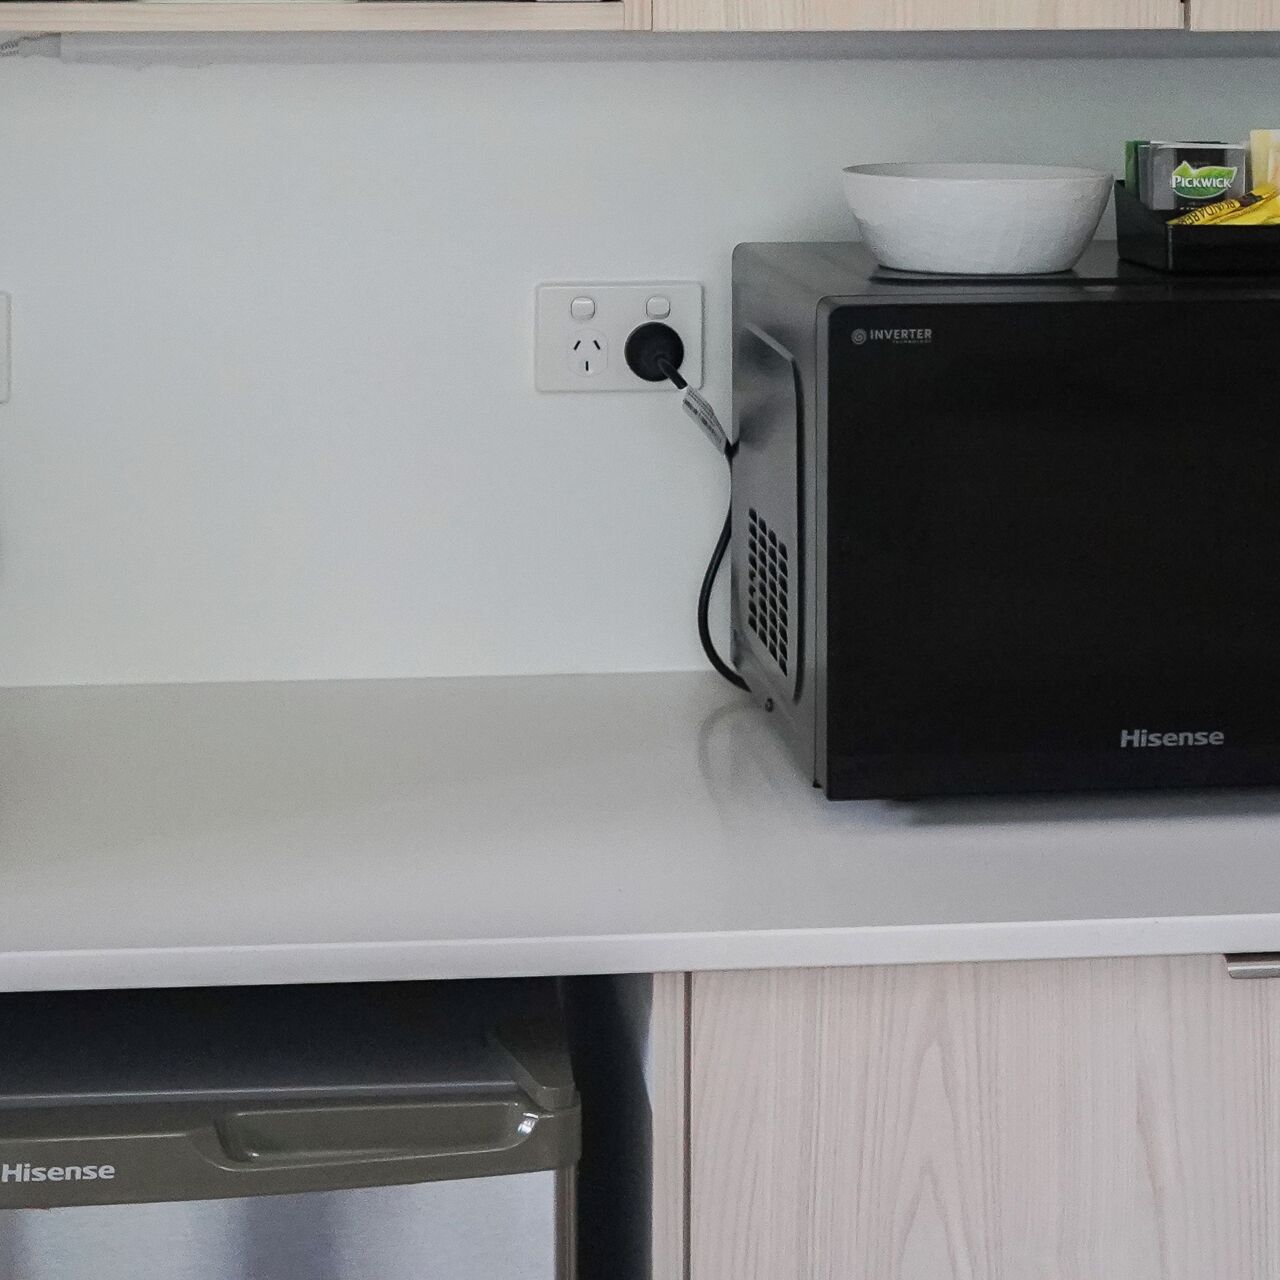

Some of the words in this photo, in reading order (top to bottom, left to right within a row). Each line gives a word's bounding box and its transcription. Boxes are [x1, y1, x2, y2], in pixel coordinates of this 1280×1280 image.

[1171, 175, 1232, 190] PICKWICK
[870, 329, 932, 340] INVERTER
[1119, 728, 1225, 748] Hisense
[0, 1162, 116, 1183] Hisense
